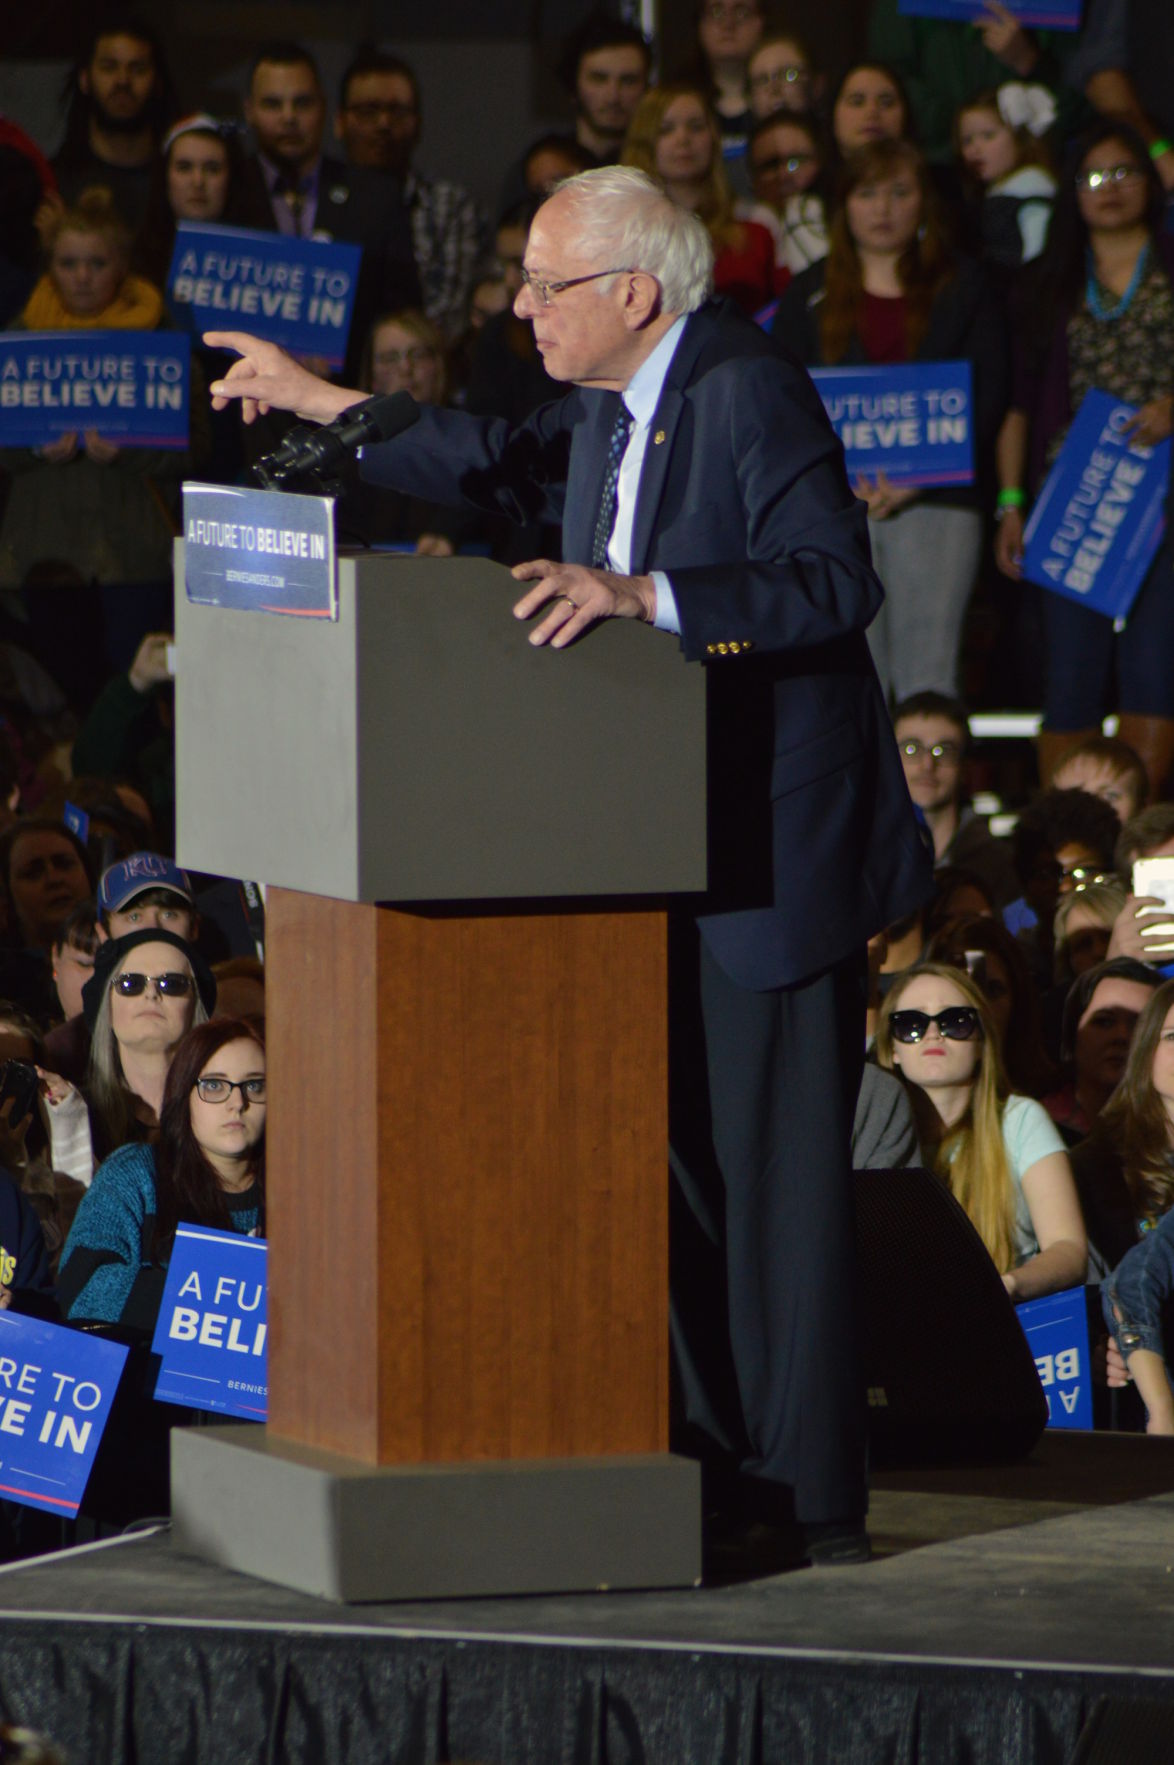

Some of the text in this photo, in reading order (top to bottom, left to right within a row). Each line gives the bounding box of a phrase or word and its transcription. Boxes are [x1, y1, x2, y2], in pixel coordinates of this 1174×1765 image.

[179, 248, 349, 297] A FUTURE TO
[173, 275, 346, 328] BELIEVE IN
[3, 355, 183, 382] A FUTURE TO
[0, 380, 182, 410] BELIEVE IN
[924, 387, 967, 416] TO
[834, 416, 967, 450] IEVE IN
[1041, 405, 1138, 582] A FUTURE TO
[188, 519, 325, 560] A FUTURE TO BELIEVE IN
[1063, 456, 1147, 595] BELIEVE
[178, 1270, 263, 1312] A FU
[168, 1306, 267, 1357] BELI
[51, 1371, 102, 1411] TO
[1058, 1386, 1080, 1414] A
[0, 1396, 93, 1455] E IN
